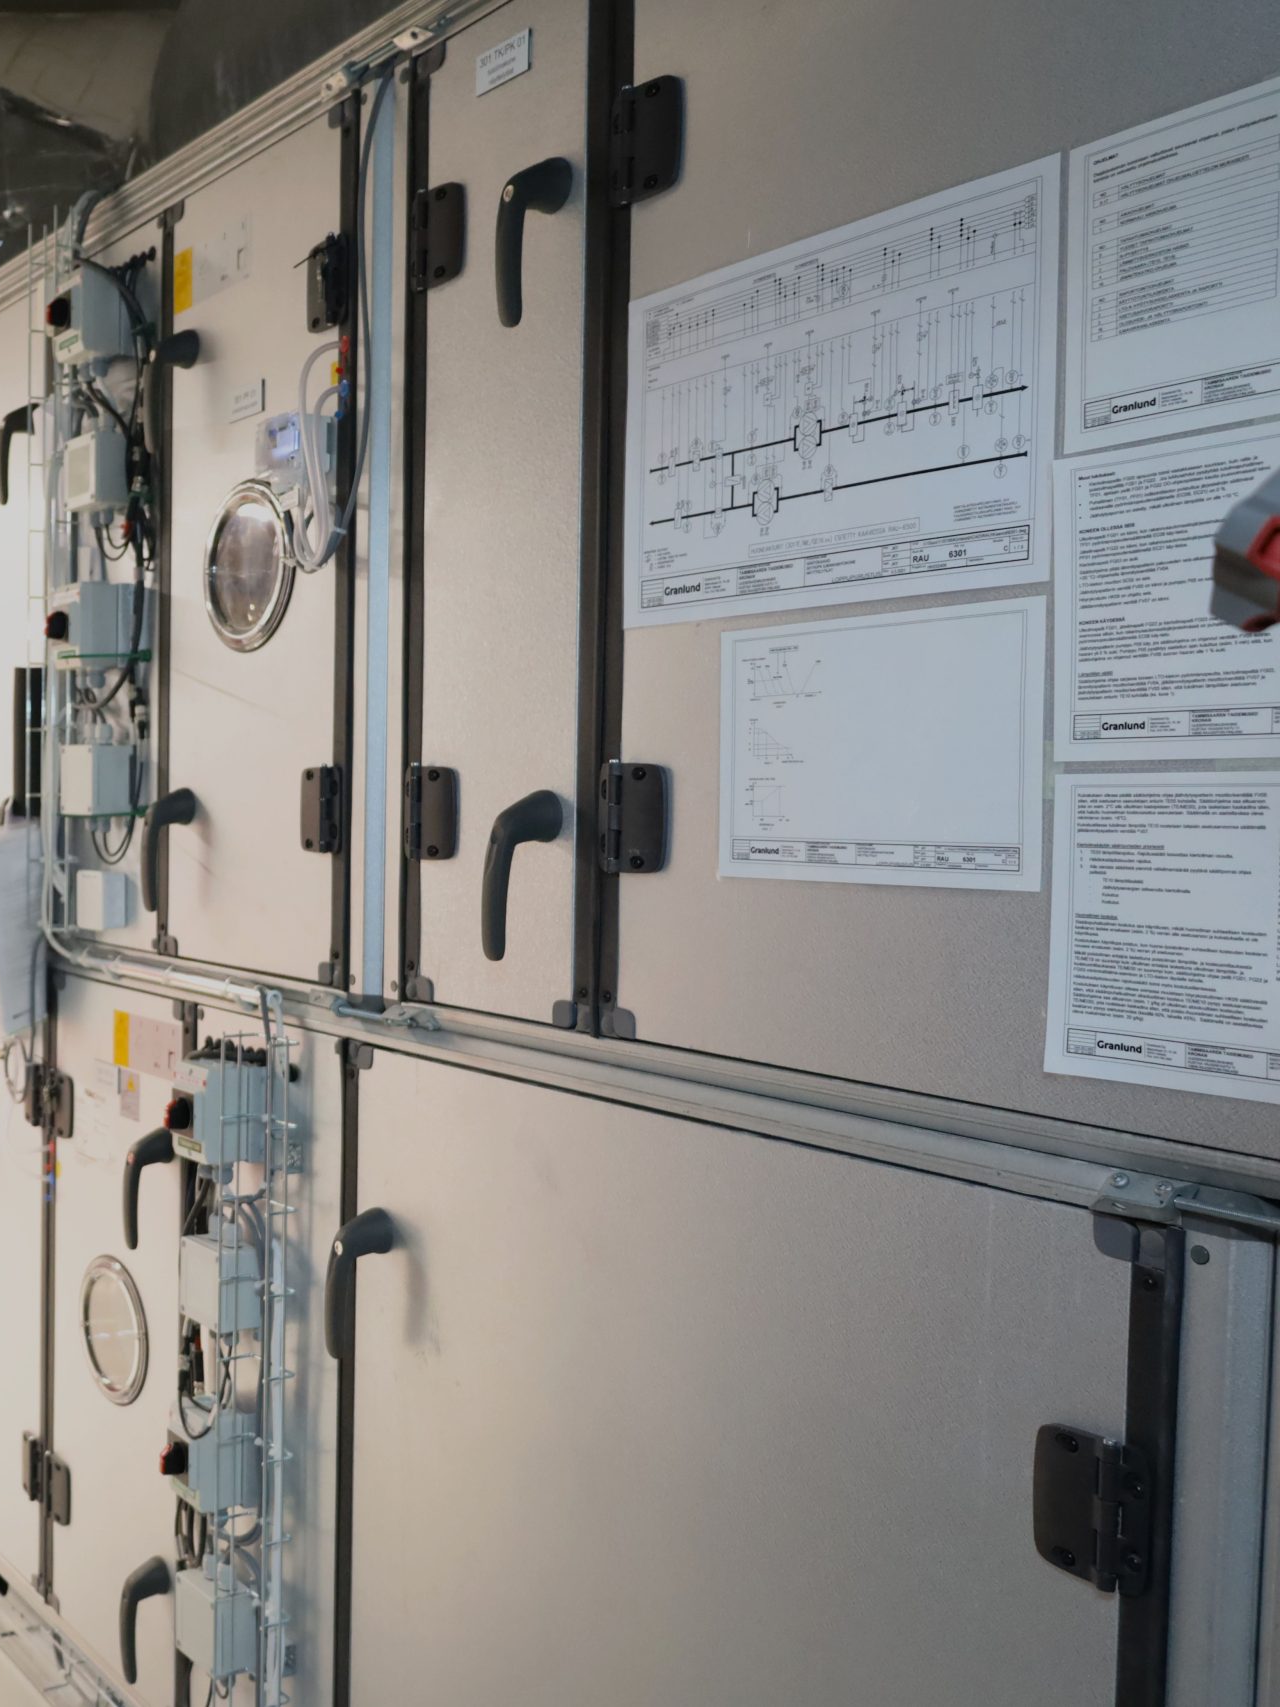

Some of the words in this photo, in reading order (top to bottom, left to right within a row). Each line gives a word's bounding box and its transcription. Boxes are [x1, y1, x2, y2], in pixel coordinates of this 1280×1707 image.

[1111, 397, 1157, 415] Granlund
[912, 553, 930, 564] RAU
[948, 548, 967, 559] 6301
[664, 581, 701, 597] Granlund
[1101, 721, 1146, 731] Granlund
[750, 846, 780, 856] Granlund
[1096, 1040, 1143, 1054] Granlund
